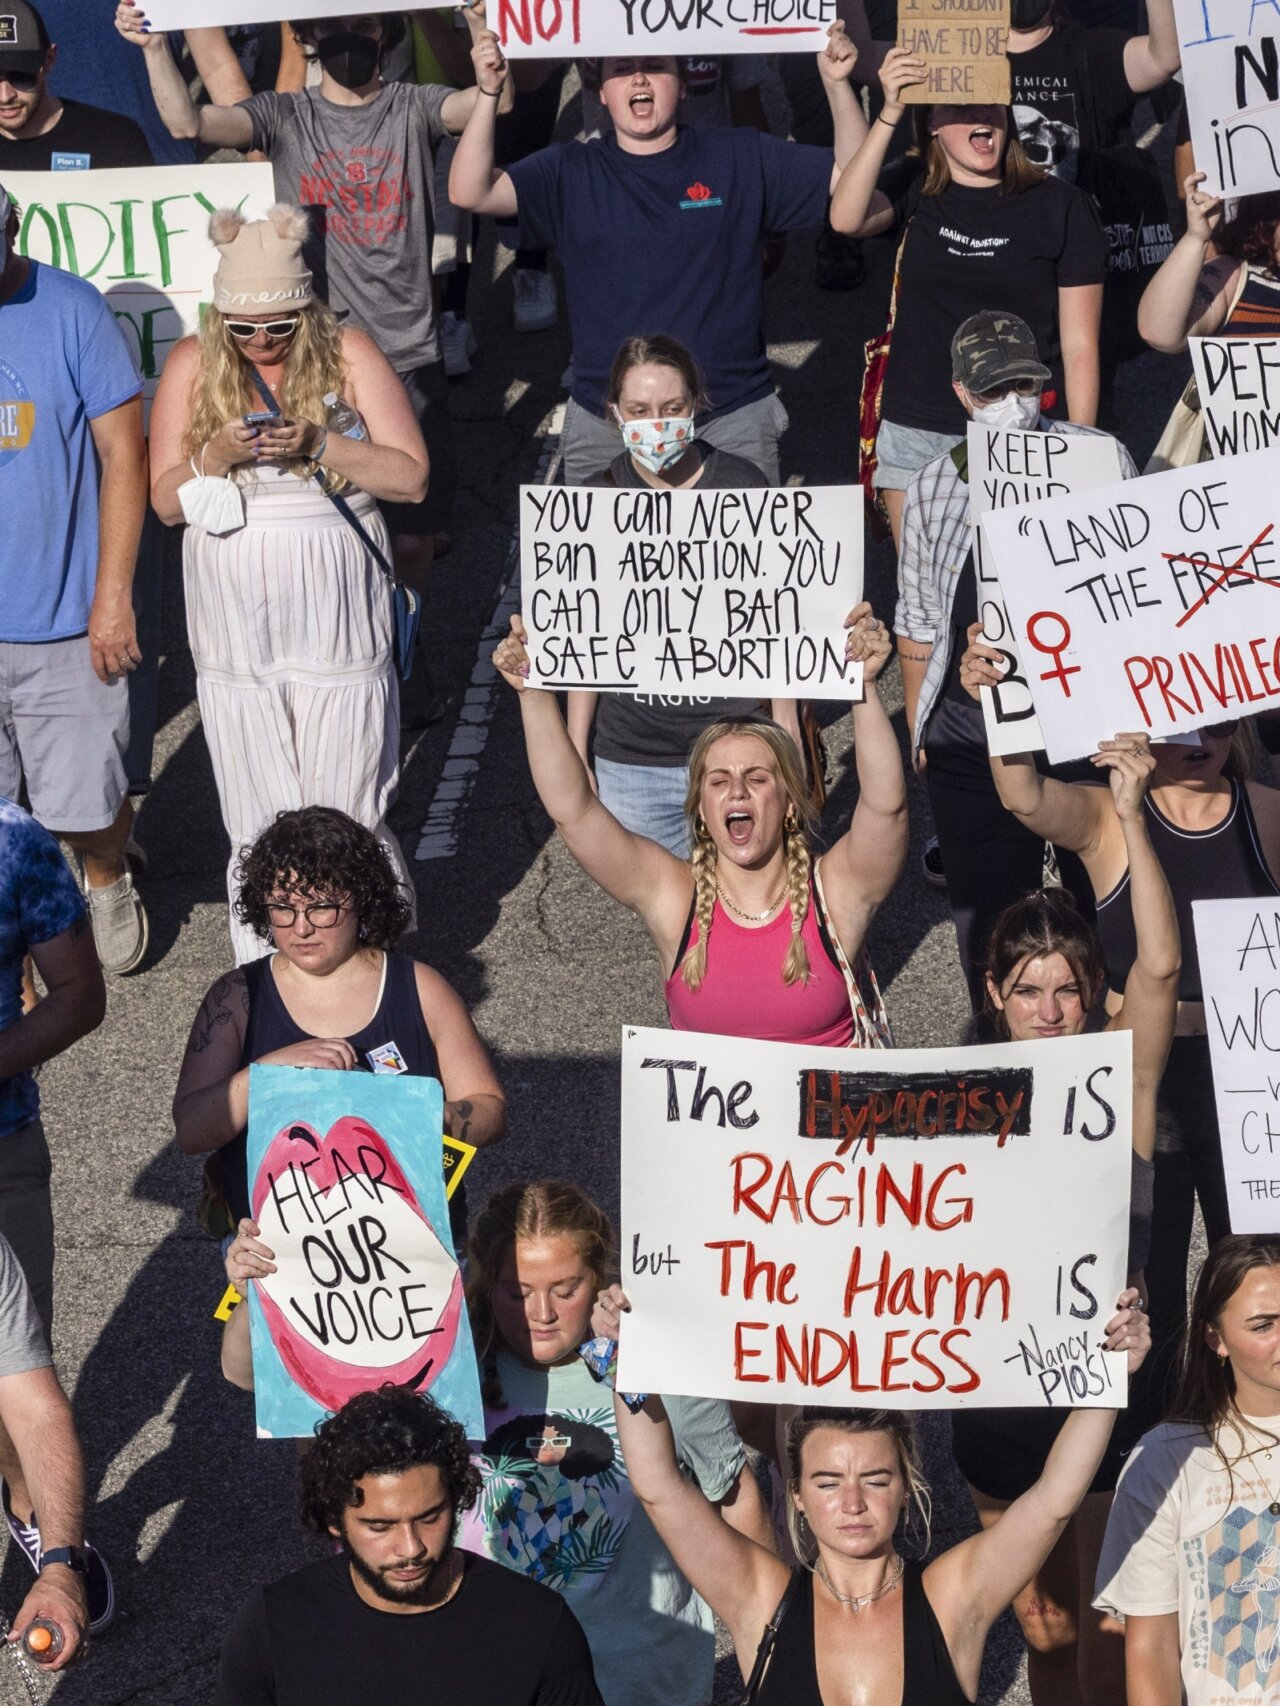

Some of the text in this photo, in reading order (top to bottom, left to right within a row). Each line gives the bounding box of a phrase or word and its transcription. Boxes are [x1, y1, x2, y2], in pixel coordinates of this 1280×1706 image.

[902, 27, 1006, 57] HAVE TO BE
[928, 66, 974, 93] HERE
[1015, 76, 1068, 88] EMICAL
[1015, 91, 1060, 101] ANCE
[986, 431, 1069, 478] KEEP
[526, 488, 594, 533] YOU
[1178, 481, 1229, 533] OF
[779, 539, 841, 587] YOU
[1064, 566, 1162, 623] THE
[640, 1057, 760, 1129] The
[267, 1145, 404, 1234] HEAR
[729, 1151, 974, 1232] RAGING
[302, 1215, 411, 1289] OUR
[633, 1234, 681, 1276] but
[705, 1239, 800, 1305] The
[843, 1246, 1011, 1326] Harm
[290, 1284, 445, 1346] VOICE
[734, 1321, 982, 1394] ENDLESS
